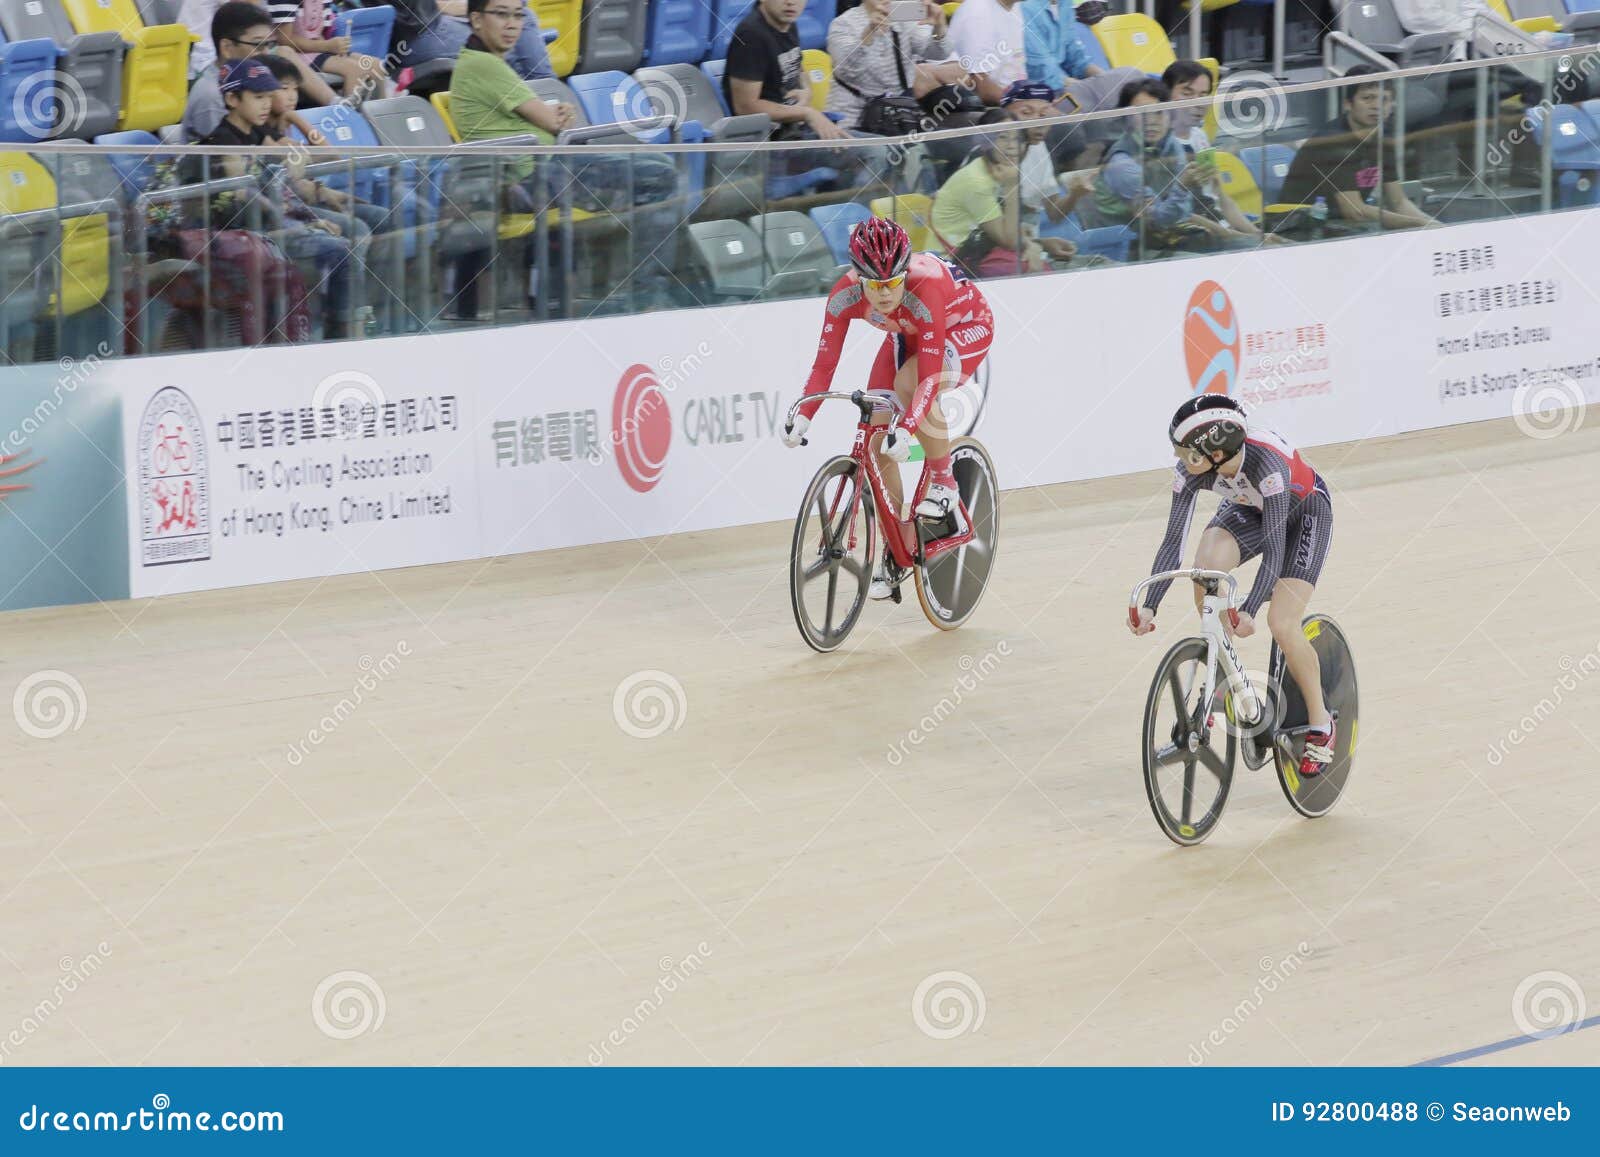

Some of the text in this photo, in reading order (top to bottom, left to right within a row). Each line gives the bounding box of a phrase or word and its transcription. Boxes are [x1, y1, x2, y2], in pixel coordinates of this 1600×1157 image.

[951, 323, 992, 347] Canon
[492, 409, 600, 468] 有線電視
[684, 391, 779, 446] CABLE TV
[237, 449, 432, 493] The Cycling Association
[220, 486, 452, 537] of Hong Kong, China Limited
[1296, 513, 1313, 569] WRC
